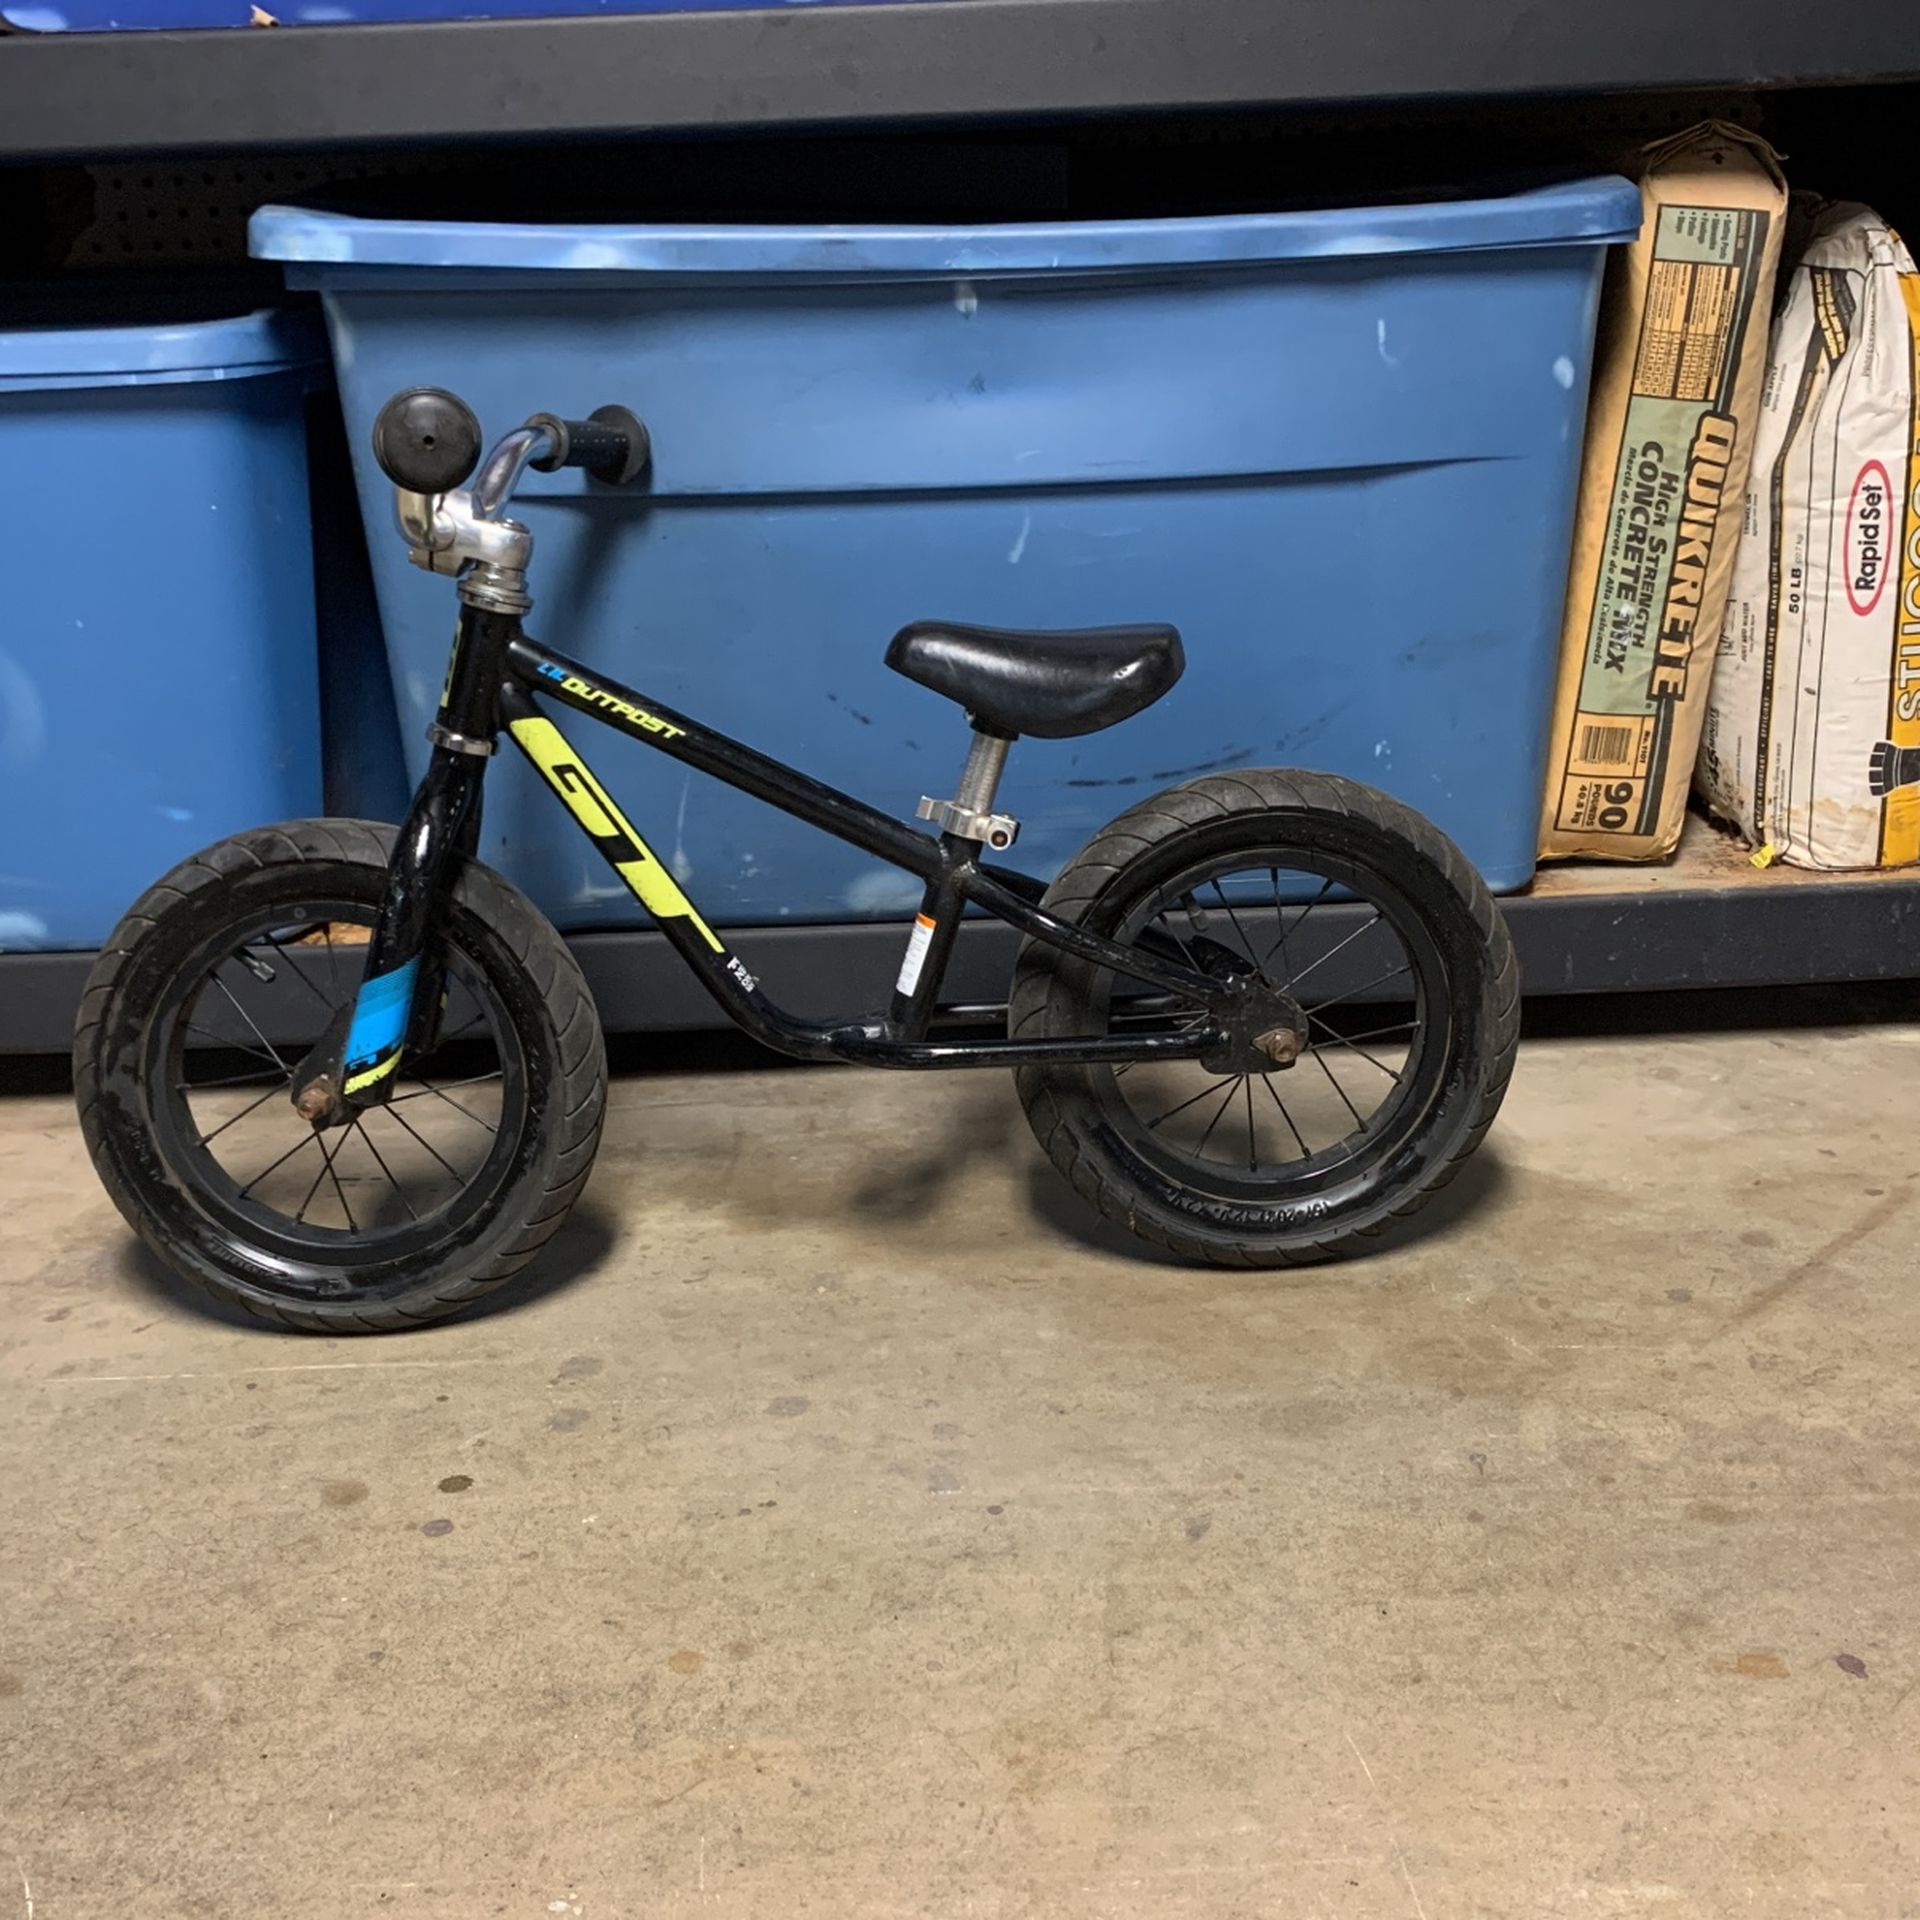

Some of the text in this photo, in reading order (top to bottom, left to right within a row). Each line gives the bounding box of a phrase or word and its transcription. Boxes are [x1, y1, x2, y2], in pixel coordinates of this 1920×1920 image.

[1622, 447, 1637, 487] Mezcla
[1619, 490, 1629, 504] de
[1855, 484, 1883, 591] Rapid Set
[1604, 441, 1664, 674] CONCRETE MIX
[1608, 560, 1619, 574] de
[1631, 471, 1680, 649] HIGH STRENGTH
[1648, 412, 1737, 700] QUIKRETE
[1603, 577, 1615, 600] Alta
[1791, 568, 1803, 590] LB
[1789, 593, 1800, 614] 50
[1767, 627, 1775, 644] USE
[1765, 659, 1773, 680] EASY
[560, 676, 687, 739] OUTPOST
[1571, 811, 1583, 824] kg
[1586, 784, 1602, 827] POUNDS
[1598, 782, 1634, 830] 90
